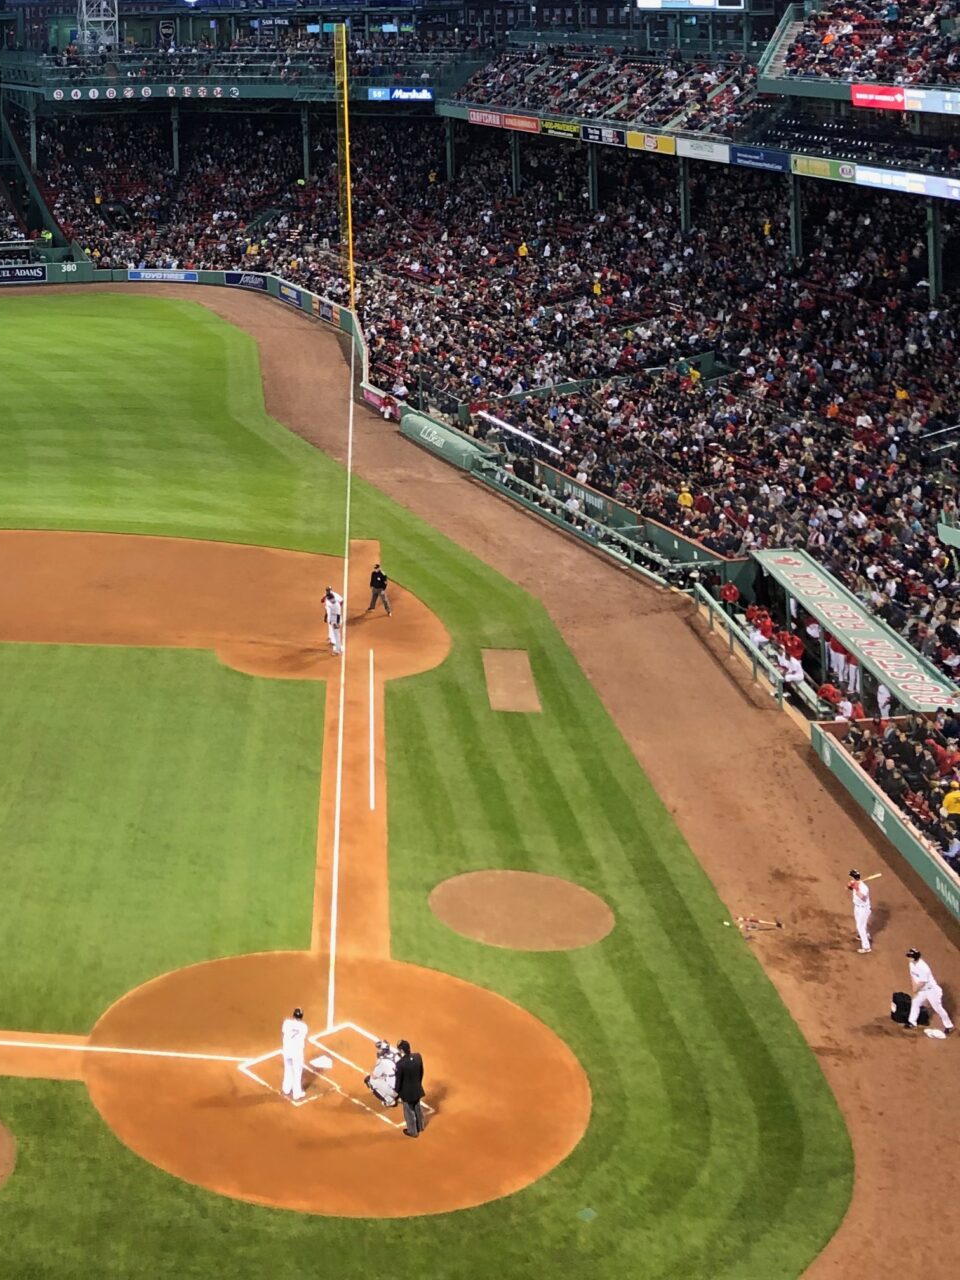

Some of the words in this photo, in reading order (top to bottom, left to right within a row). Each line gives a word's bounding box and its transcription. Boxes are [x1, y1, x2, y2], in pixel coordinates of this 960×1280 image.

[392, 89, 432, 100] Marshalls
[470, 111, 500, 125] CRAFTSMAN
[14, 267, 43, 278] ADAMS
[61, 264, 77, 273] 380
[779, 569, 839, 599] SOX
[815, 601, 874, 632] RED
[850, 637, 958, 706] BOSTON
[290, 1028, 300, 1039] 7
